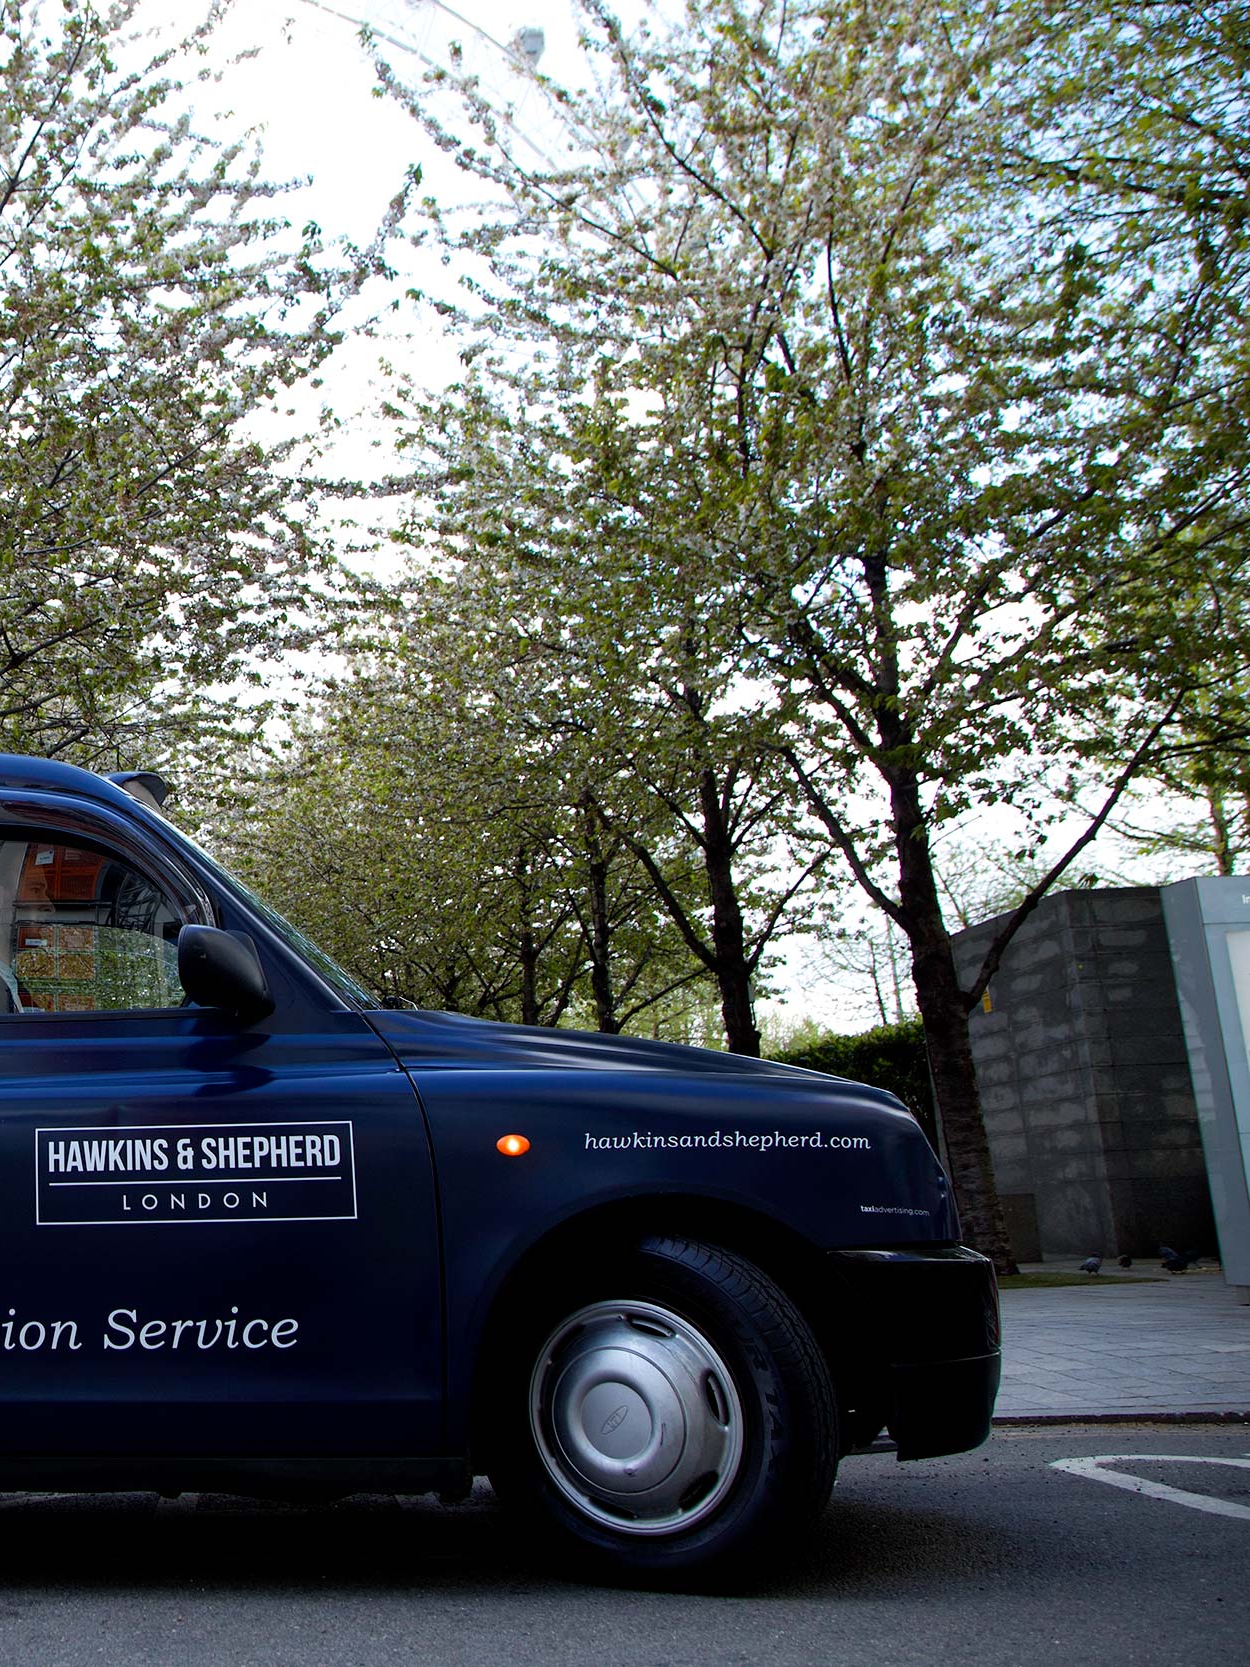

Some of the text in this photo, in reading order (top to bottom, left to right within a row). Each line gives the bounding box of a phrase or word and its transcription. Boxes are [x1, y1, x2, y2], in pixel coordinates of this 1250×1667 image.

[584, 1130, 871, 1152] hawkinsandshepherd.com
[48, 1134, 341, 1173] HAWKINS & SHEPHERD
[122, 1191, 268, 1211] LONDON
[860, 1205, 930, 1216] taxiadvertising.com
[102, 1306, 299, 1350] Service
